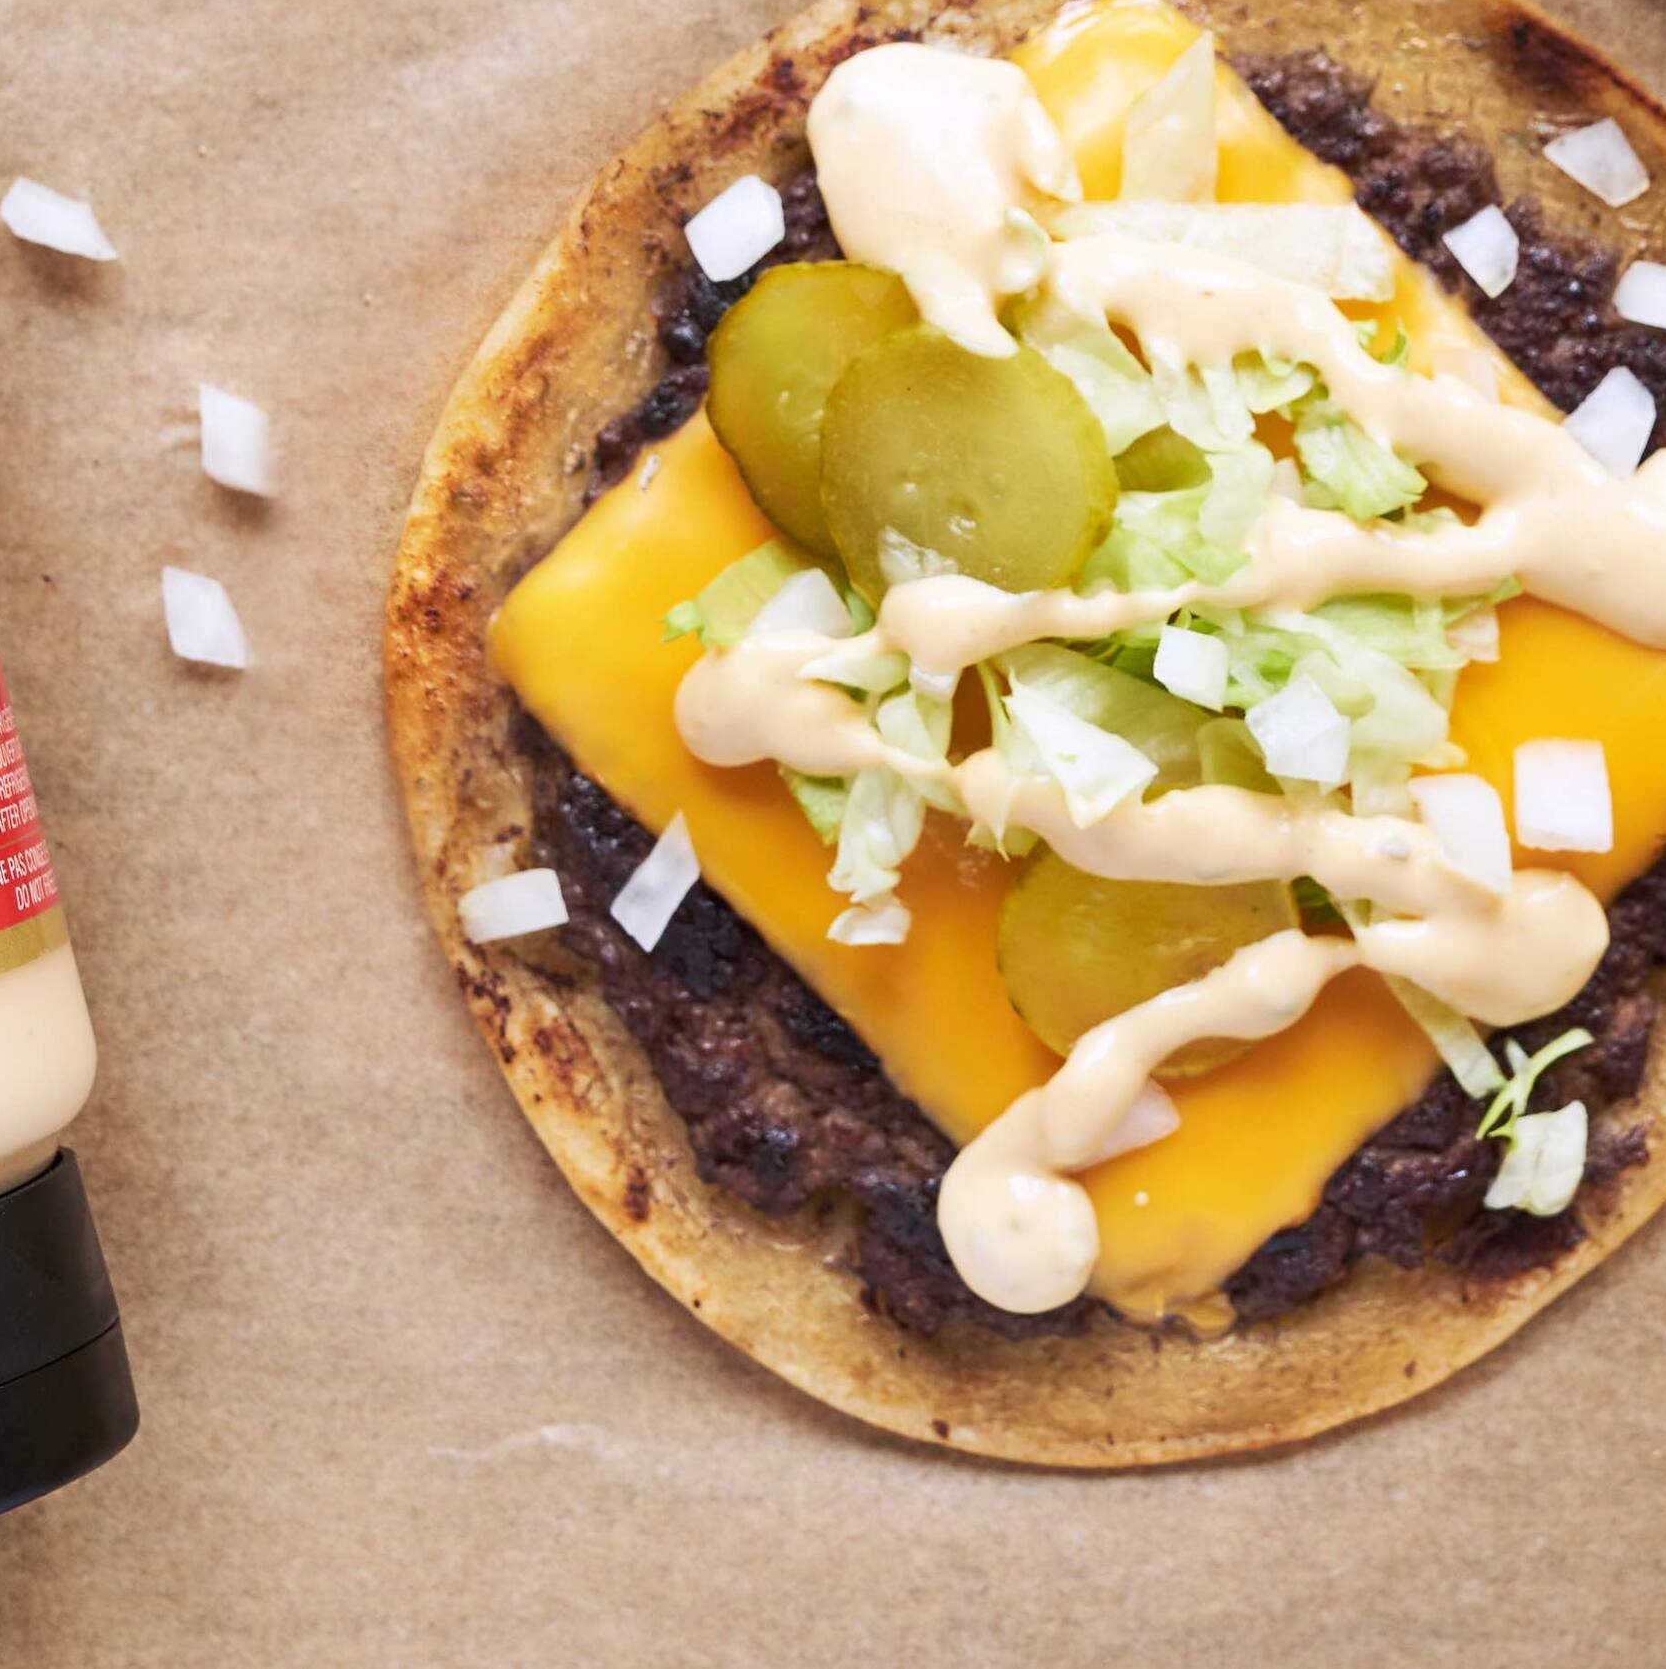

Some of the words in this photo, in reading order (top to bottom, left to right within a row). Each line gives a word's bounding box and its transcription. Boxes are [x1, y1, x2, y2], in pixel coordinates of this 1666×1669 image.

[7, 852, 28, 880] PAS
[15, 883, 30, 910] DO
[29, 876, 45, 904] NOT
